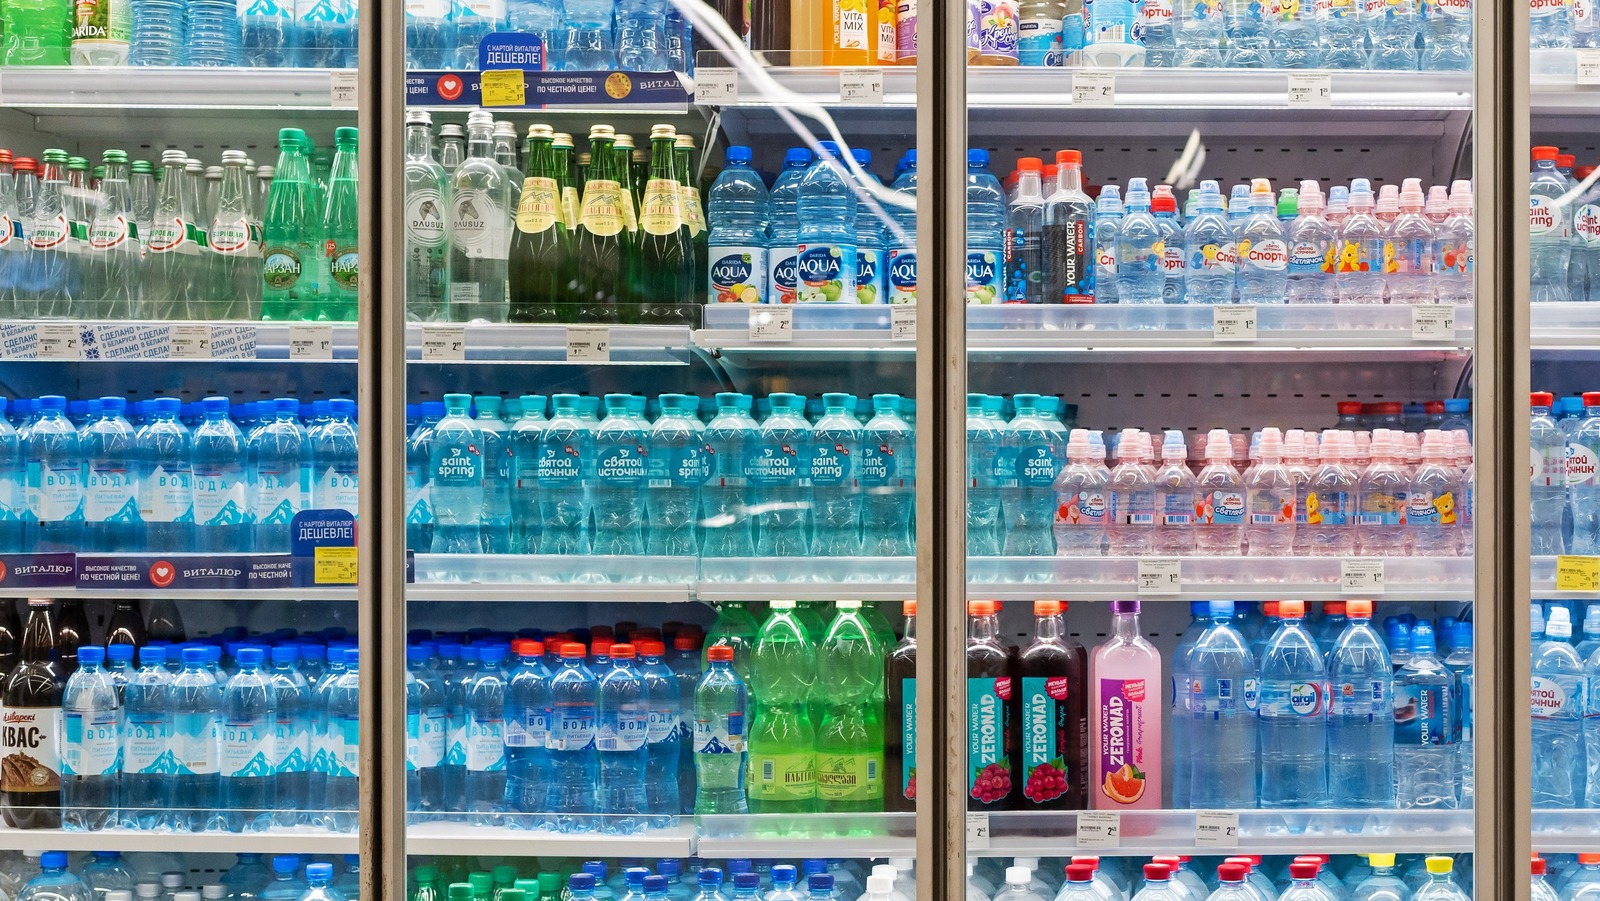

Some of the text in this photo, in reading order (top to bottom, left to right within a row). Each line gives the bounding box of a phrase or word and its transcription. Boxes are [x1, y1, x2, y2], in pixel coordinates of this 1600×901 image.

[843, 13, 863, 21] VITA
[844, 21, 864, 31] MIX
[880, 25, 894, 34] VITA
[881, 34, 895, 44] MIX
[487, 52, 540, 64] ДЕШЕВЛЕ!
[547, 85, 573, 93] ЧЕСТНОЙ
[575, 85, 597, 94] ЦЕНЕ!
[1067, 221, 1075, 286] YOUR WATER
[799, 260, 840, 273] AQUA
[713, 266, 748, 279] AQUA
[100, 326, 134, 341] СДЕЛАНО
[4, 333, 37, 348] СДЕЛАНО
[108, 335, 136, 347] БЕЛАРУСИ
[105, 344, 139, 358] СДЕЛАНО
[442, 456, 471, 466] saint
[604, 458, 642, 467] святой
[812, 456, 838, 466] saint
[1028, 458, 1052, 467] saint
[439, 467, 474, 477] spring
[811, 466, 842, 477] spring
[1024, 467, 1054, 477] spring
[91, 476, 131, 487] ВОДА
[299, 528, 353, 541] ДЕШЕВЛЕ!
[15, 565, 73, 575] ВИТАЛЮР
[184, 568, 242, 578] ВИТАЛЮР
[1292, 692, 1315, 706] argil
[563, 721, 594, 730] ВОДА
[980, 693, 995, 763] ZERONAD
[1032, 693, 1047, 763] ZERONAD
[1110, 696, 1124, 765] ZERONAD
[2, 726, 39, 748] КВАС
[128, 728, 166, 739] ВОДА
